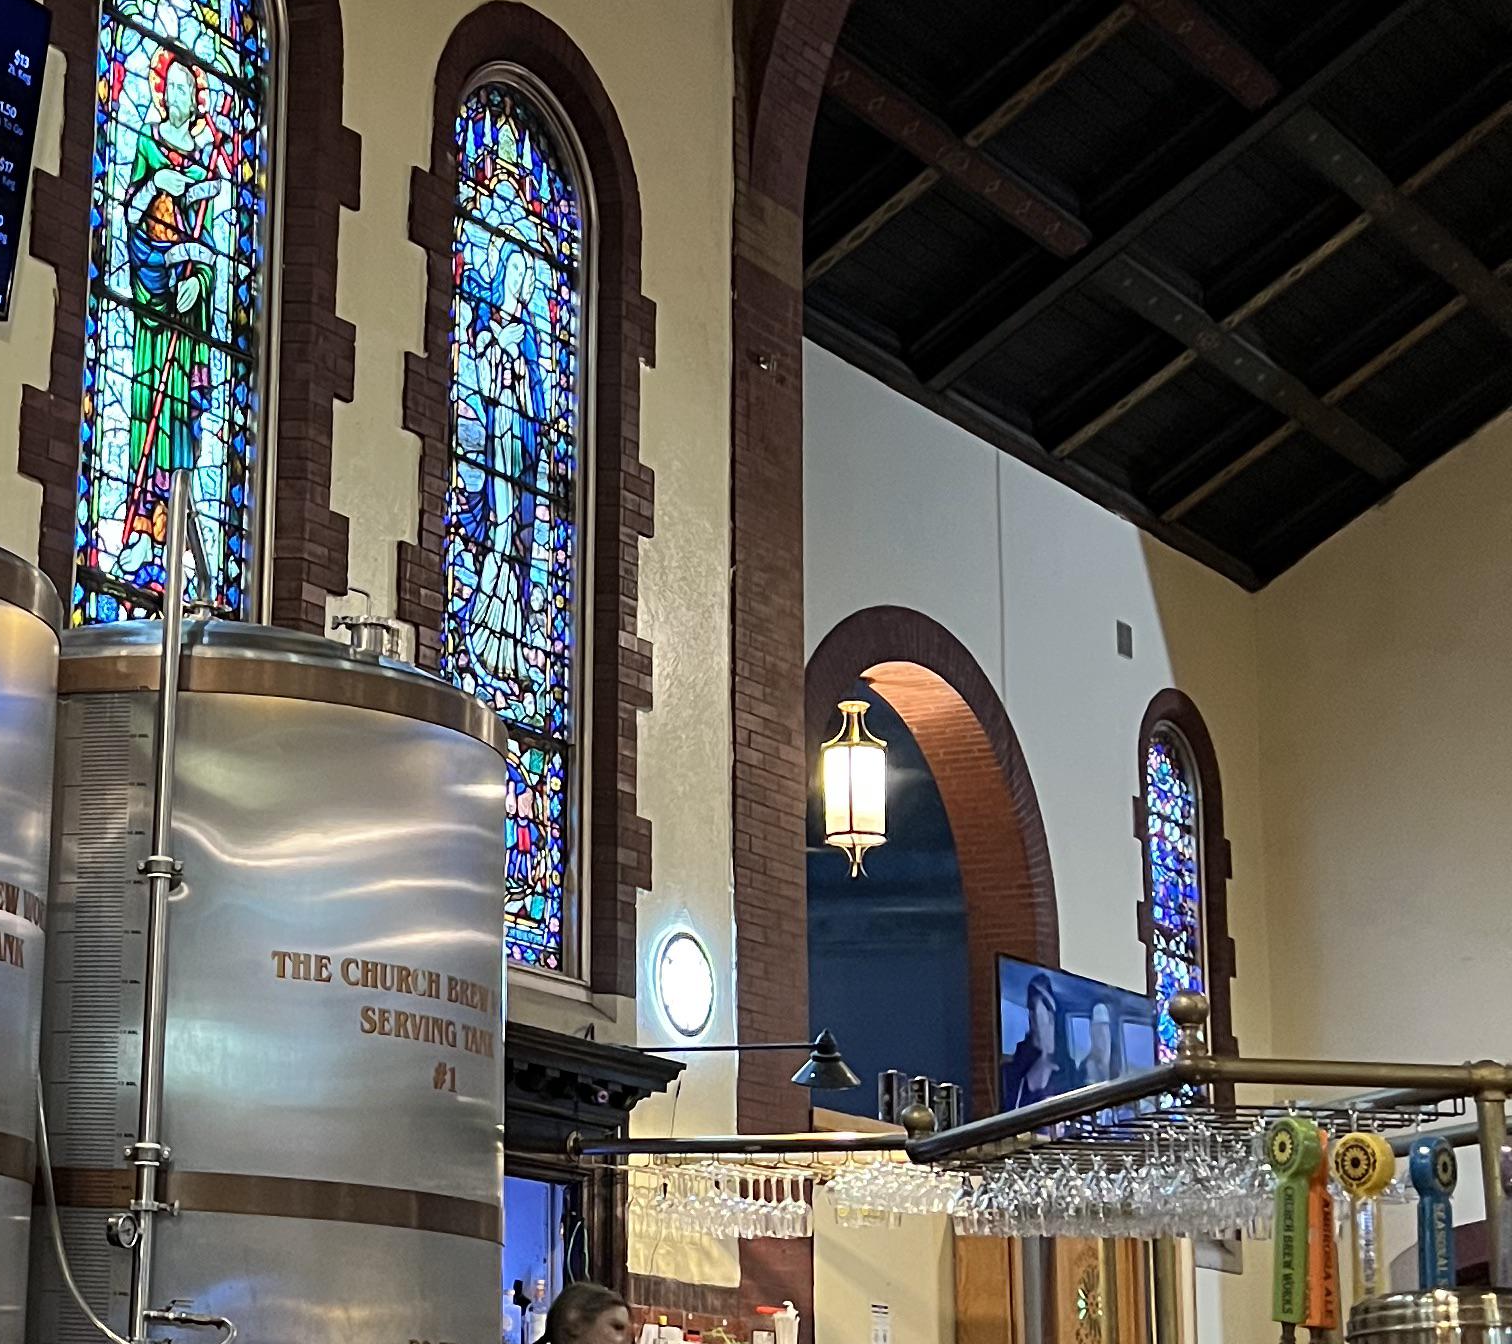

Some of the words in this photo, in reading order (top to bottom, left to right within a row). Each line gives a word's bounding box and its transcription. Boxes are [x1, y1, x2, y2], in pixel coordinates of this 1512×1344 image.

[271, 950, 332, 983] THE
[340, 957, 441, 1000] CHURCH
[360, 1005, 457, 1048] SERVING
[432, 1061, 458, 1093] #1
